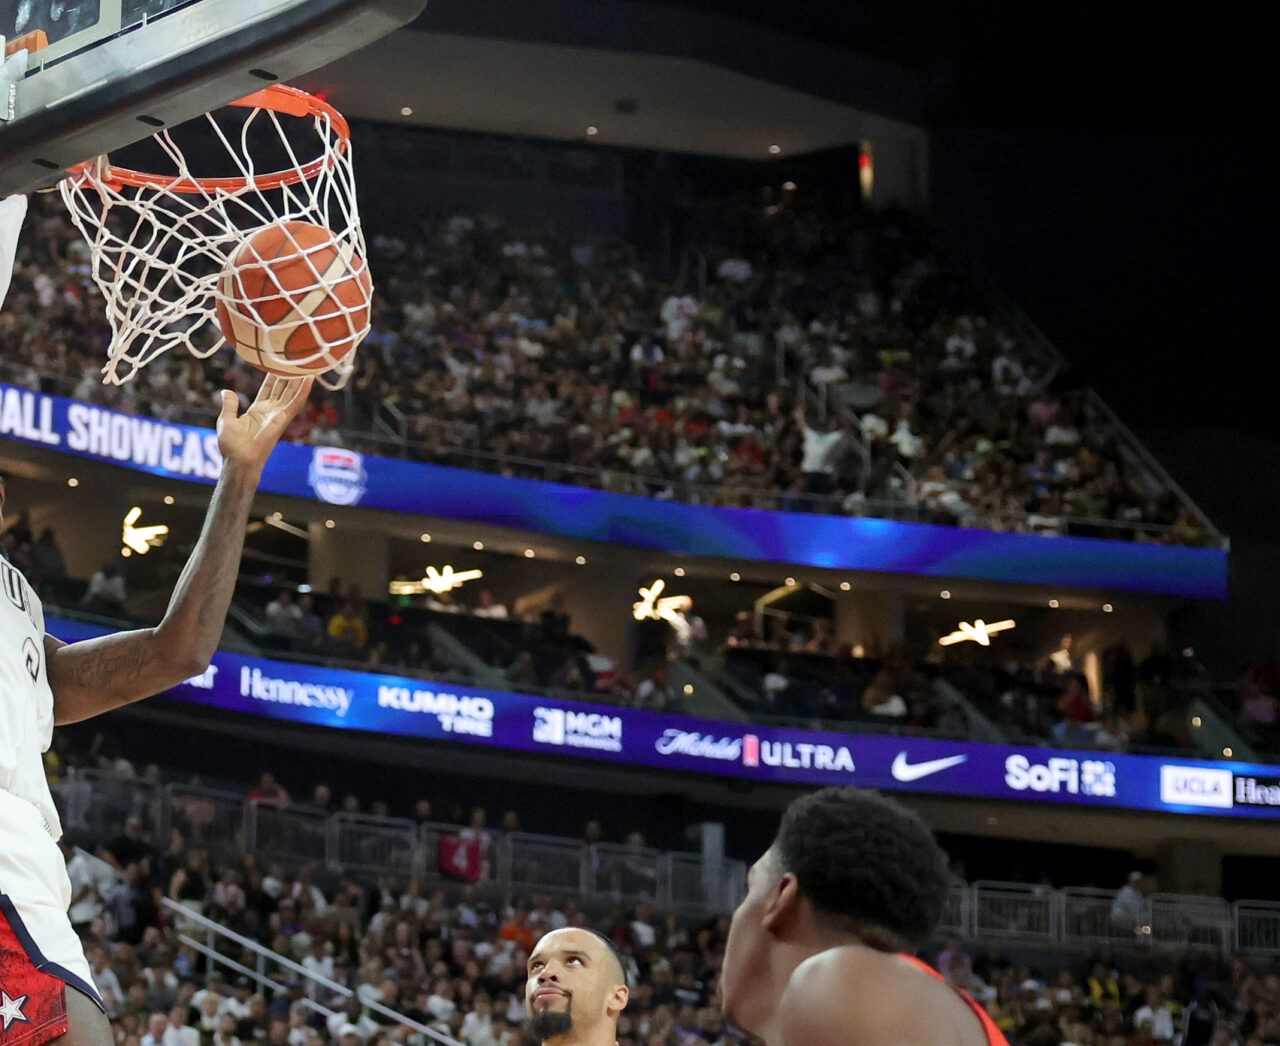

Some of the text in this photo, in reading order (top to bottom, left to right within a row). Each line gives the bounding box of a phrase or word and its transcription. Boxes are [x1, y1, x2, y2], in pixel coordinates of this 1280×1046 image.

[67, 402, 222, 480] SHOWCAS
[240, 665, 354, 718] Hennessy
[377, 685, 494, 721] KUMHO
[760, 740, 856, 772] ULTRA
[1004, 754, 1079, 795] SoFi
